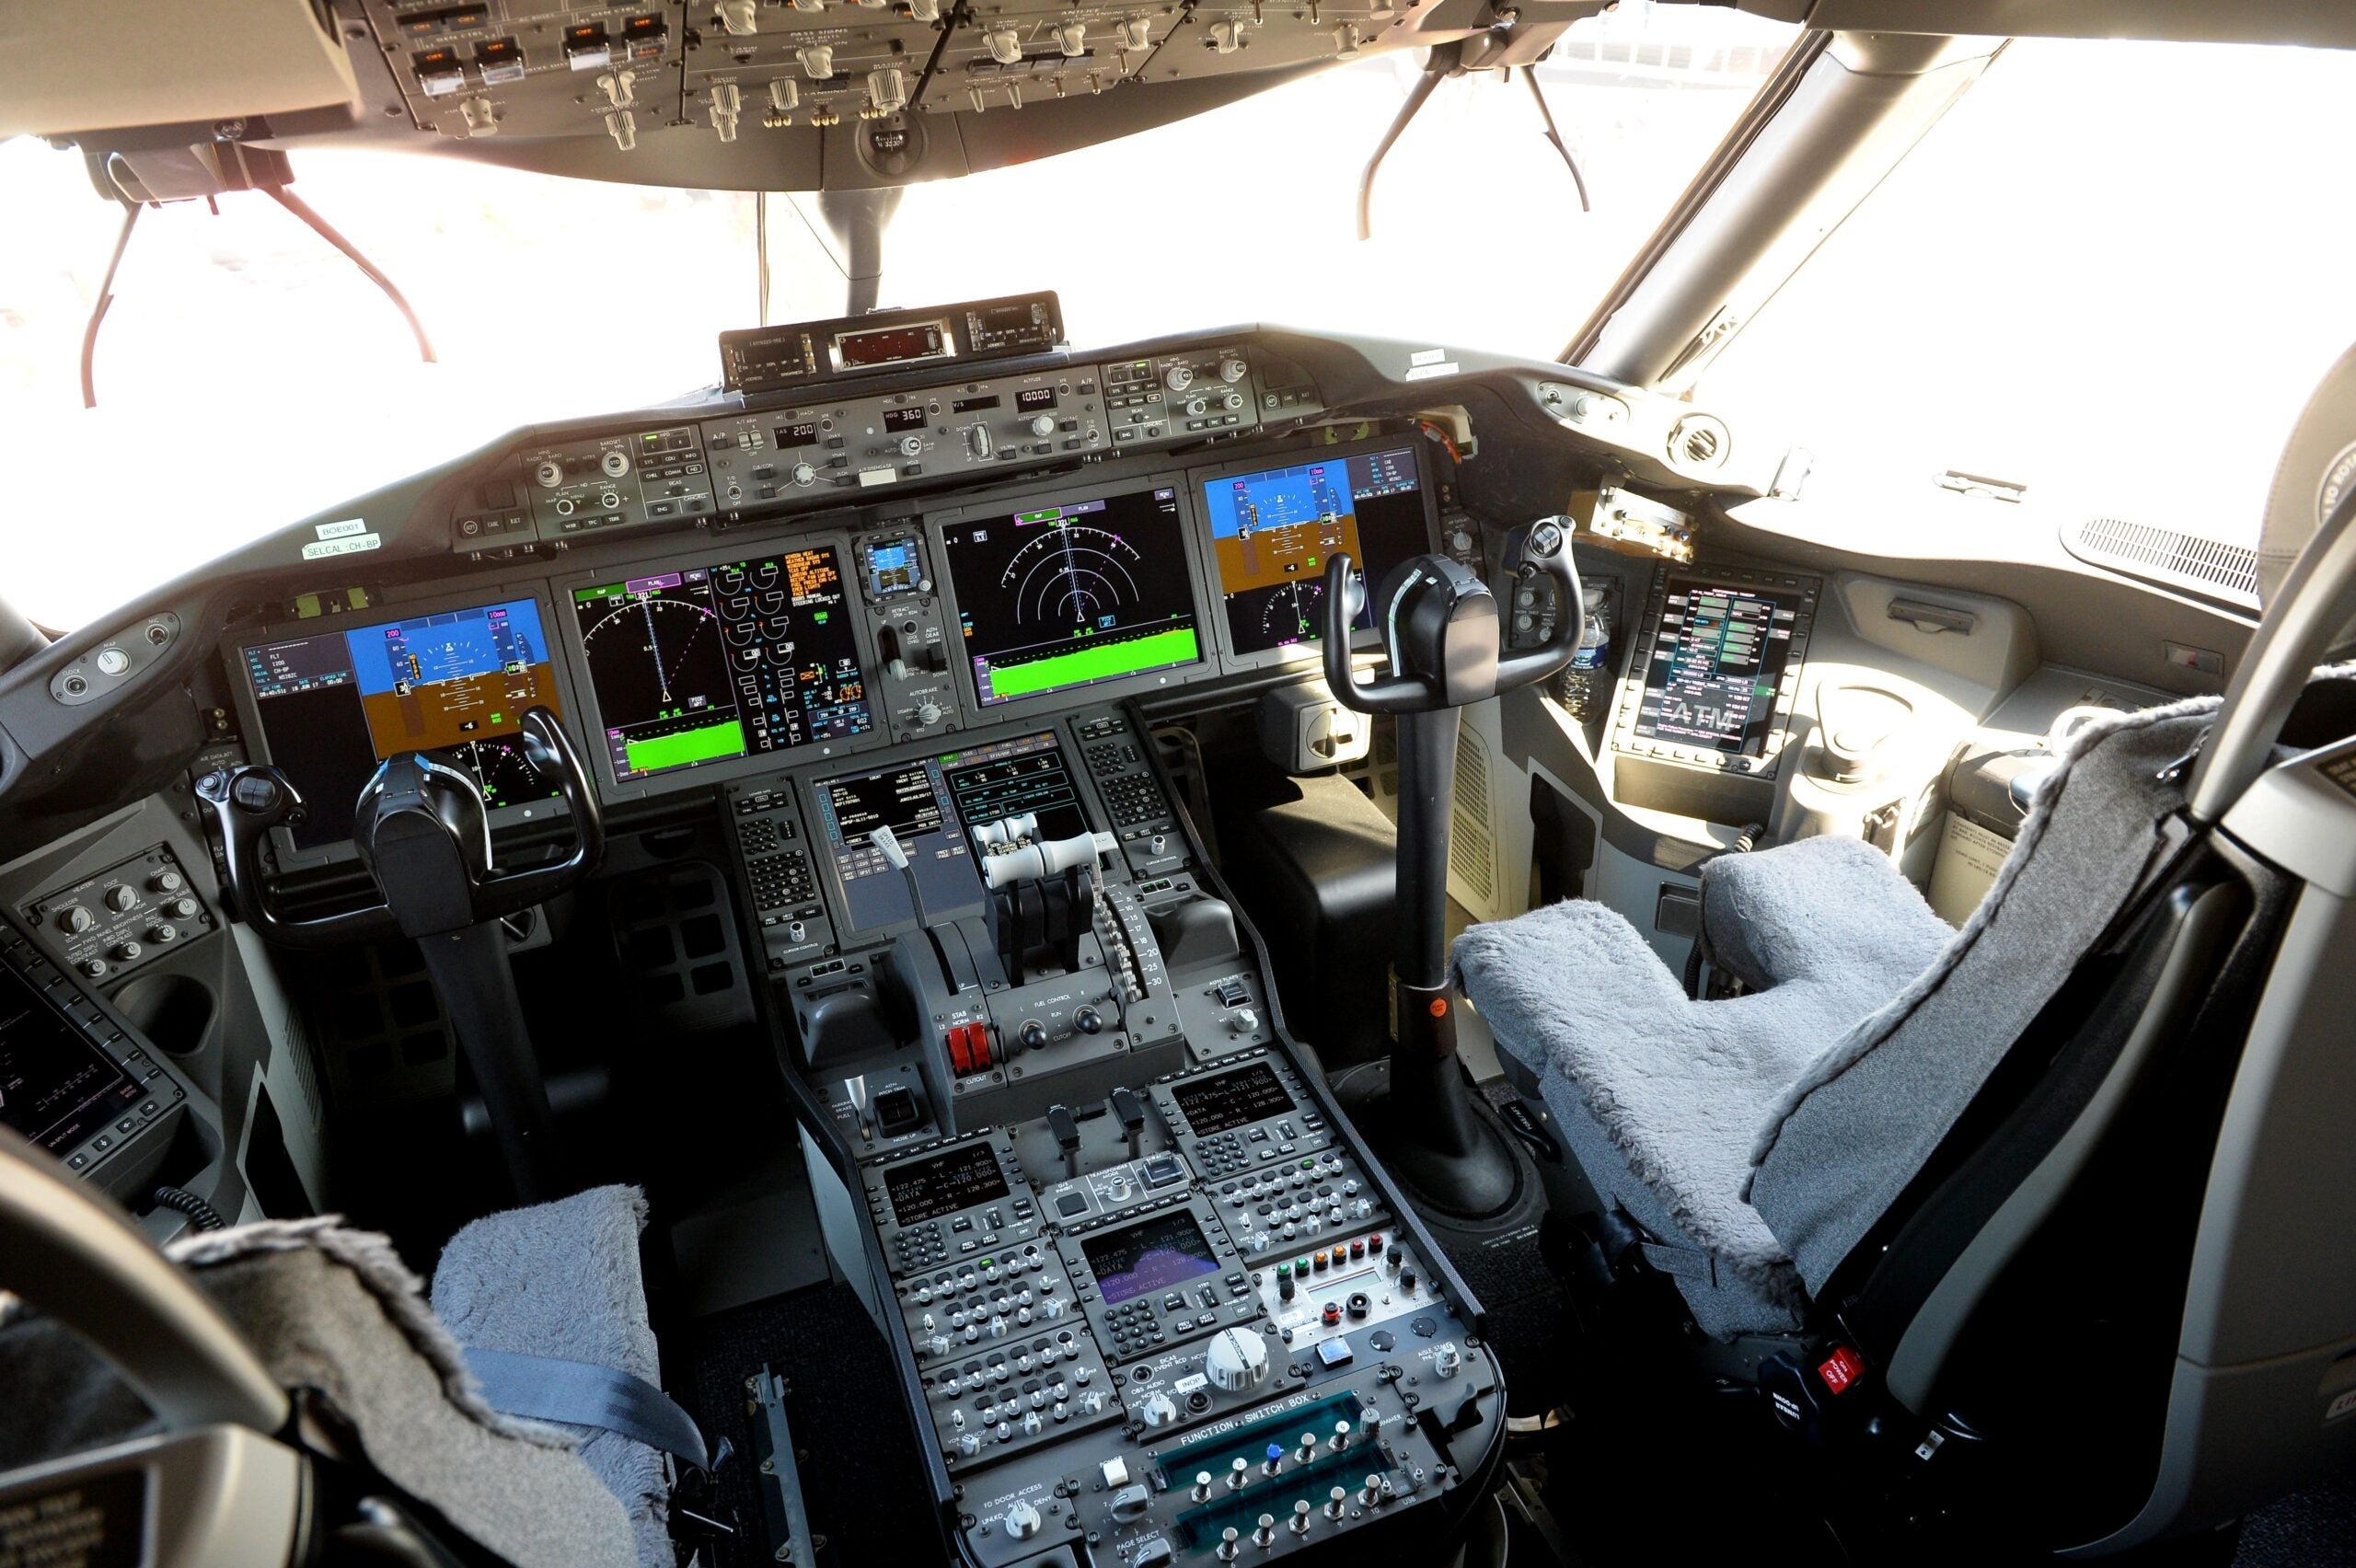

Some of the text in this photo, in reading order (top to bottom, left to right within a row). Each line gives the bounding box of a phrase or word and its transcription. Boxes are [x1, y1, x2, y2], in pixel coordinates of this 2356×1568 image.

[1080, 377, 1093, 386] A/P
[1022, 389, 1050, 402] 10000
[901, 409, 921, 421] 360
[793, 424, 814, 436] 200
[386, 629, 399, 638] 200
[909, 686, 939, 697] AUTOBRAKE
[150, 866, 167, 877] CHART
[72, 881, 95, 894] HEATERS
[159, 888, 191, 905] WORK TABLE
[52, 897, 79, 913] SHOULDER
[111, 912, 125, 921] LOW
[81, 913, 144, 946] FWD PANEL BRIGHTNESS
[64, 935, 78, 943] LOW
[106, 931, 133, 948] CONTRAST
[70, 949, 98, 965] CONTRAST
[1147, 948, 1159, 958] 20
[1148, 963, 1158, 972] 25
[1151, 977, 1162, 986] 30
[1046, 994, 1071, 1006] CONTROL
[952, 1010, 967, 1020] STAB
[952, 1018, 970, 1027] NORM
[1053, 1033, 1072, 1043] CUTOFF
[966, 1075, 987, 1085] CUTOUT
[1224, 1117, 1250, 1128] ACTIVE
[931, 1161, 945, 1170] VHF
[1090, 1164, 1128, 1179] TRANSPONDER
[931, 1203, 959, 1216] ACTIVE
[1018, 1208, 1033, 1216] MENU
[1138, 1277, 1167, 1291] ACTIVE
[1232, 1284, 1248, 1292] MENU
[1223, 1298, 1239, 1307] PANEL
[1198, 1312, 1212, 1320] NEXT
[1159, 1355, 1177, 1365] EICAS
[1191, 1350, 1207, 1361] NOSE
[1154, 1357, 1187, 1373] EVENT RCD
[1839, 1360, 1848, 1373] ON
[1826, 1369, 1839, 1384] OFF
[1829, 1359, 1848, 1384] POWER
[1131, 1379, 1165, 1396] OBS AUDIO
[1182, 1377, 1200, 1389] INOP
[1141, 1389, 1161, 1400] NORM
[1126, 1401, 1143, 1411] CAPT
[1774, 1401, 1800, 1421] LUMBAR
[1180, 1393, 1310, 1447] FUNCTION SWITCH BOX
[984, 1482, 1043, 1509] FD DOOR ACCESS
[1034, 1495, 1052, 1507] DENY
[1402, 1495, 1416, 1506] USB
[1370, 1506, 1380, 1516] 10
[981, 1513, 1004, 1526] UNLKD
[1115, 1530, 1161, 1551] PAGE SELECT
[1302, 1533, 1308, 1541] 8
